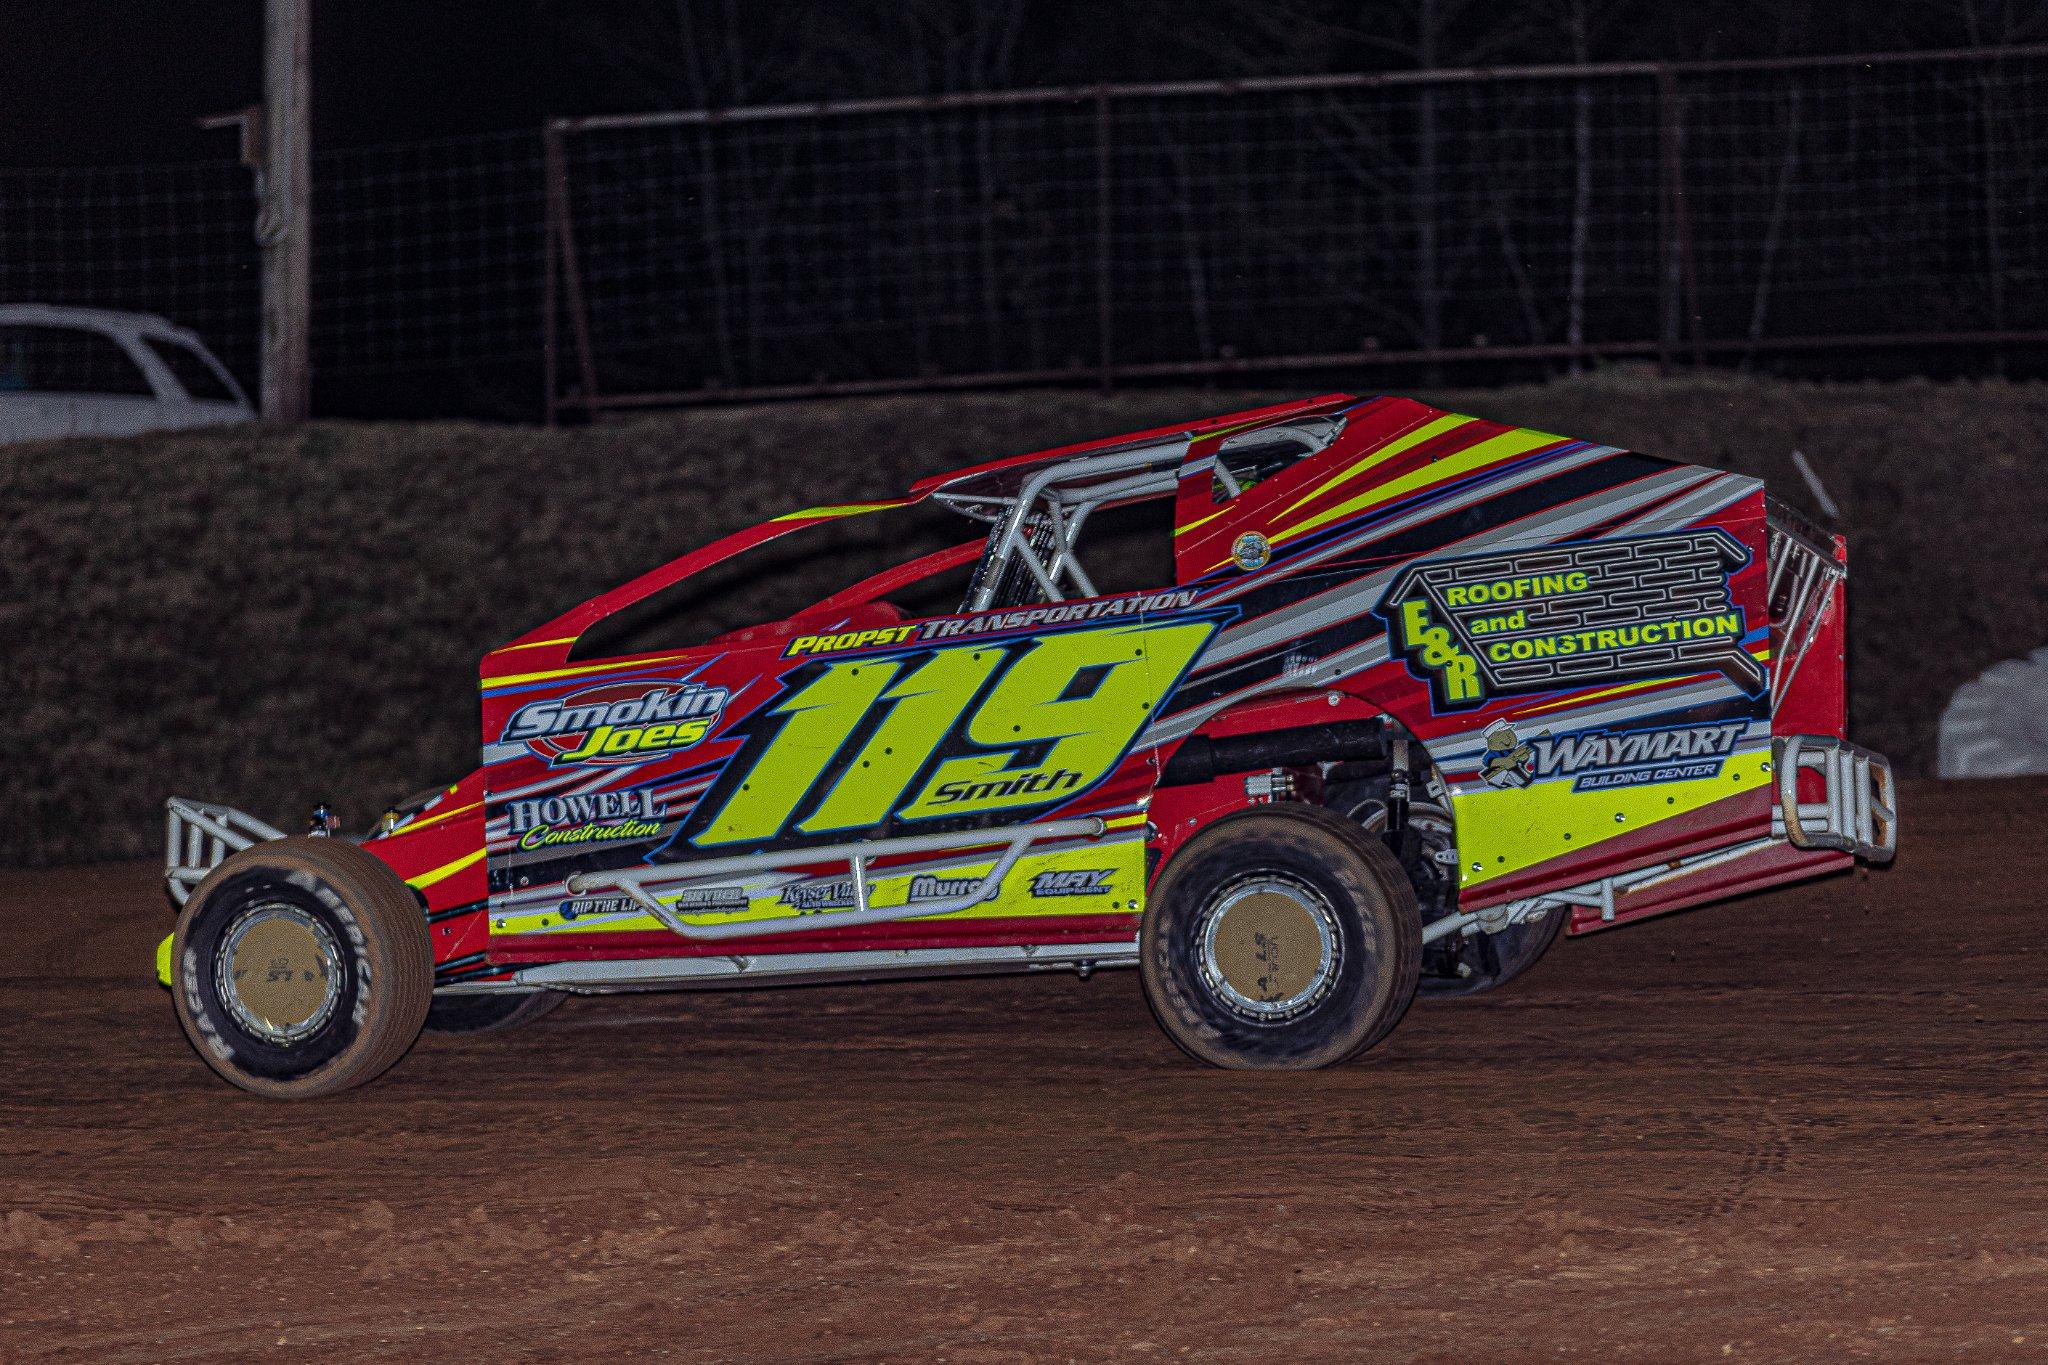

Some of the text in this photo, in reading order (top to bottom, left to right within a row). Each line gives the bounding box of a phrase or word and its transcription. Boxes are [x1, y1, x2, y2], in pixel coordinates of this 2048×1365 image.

[1447, 572, 1589, 607] ROOFING
[787, 590, 1199, 657] PROPST TRANSPORTATION
[1471, 612, 1526, 635] and
[1489, 614, 1740, 662] CONSTRUCTION
[510, 687, 727, 739] Smokin
[562, 720, 711, 761] Joes
[689, 621, 1220, 847] 119
[1535, 723, 1748, 776] WAYMART
[927, 769, 1083, 806] Smith
[1578, 764, 1717, 788] BUILDING CENTER
[507, 788, 667, 833] HOWELL
[519, 819, 662, 850] Construction
[910, 877, 999, 900] Murra
[1033, 868, 1117, 889] MAY
[1035, 885, 1111, 896] EQUIPMENT
[594, 898, 618, 912] THE
